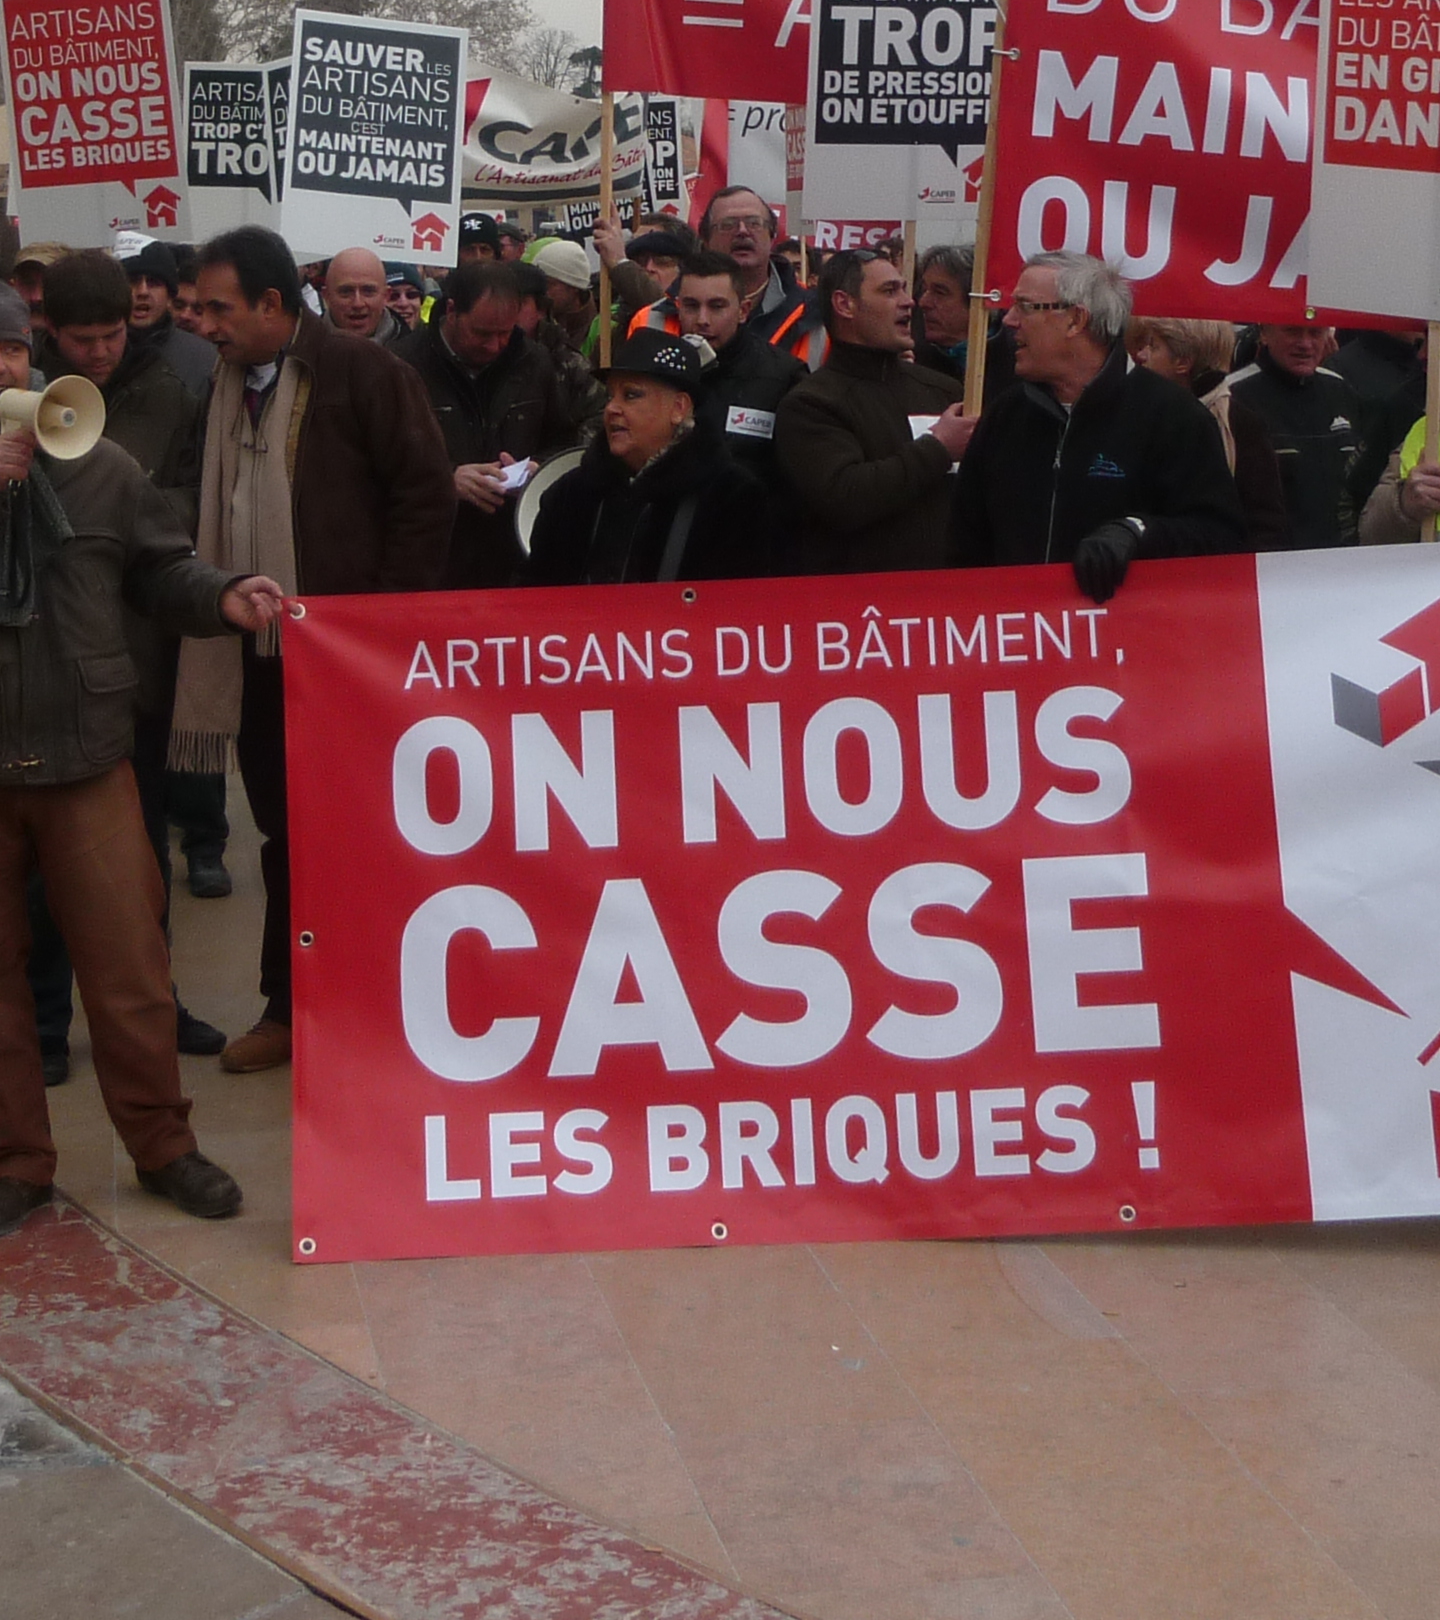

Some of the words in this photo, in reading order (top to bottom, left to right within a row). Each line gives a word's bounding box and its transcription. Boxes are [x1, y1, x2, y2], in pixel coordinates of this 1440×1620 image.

[11, 2, 155, 41] ARTISANS
[830, 5, 998, 67] TROP
[1337, 16, 1381, 47] DU
[13, 47, 44, 69] DU
[49, 36, 160, 67] BÂTIMENT,
[304, 37, 425, 73] SAUVER
[426, 62, 452, 77] LES
[1335, 52, 1389, 90] EN
[16, 69, 62, 102] ON
[71, 61, 162, 97] NOUS
[302, 65, 451, 103] ARTISANS
[824, 70, 860, 94] DE
[21, 96, 168, 146] CASSE
[192, 104, 215, 120] DU
[302, 94, 332, 116] DU
[339, 96, 448, 131] BÂTIMENT,
[822, 97, 864, 124] ON
[870, 90, 991, 124] ÉTOUFF
[191, 122, 242, 140] TROP
[298, 129, 448, 161] MAINTENANT
[351, 121, 386, 135] C'EST
[23, 147, 65, 171] LES
[71, 140, 172, 168] BRIQUES
[297, 151, 336, 176] OU
[340, 155, 446, 188] JAMAIS
[572, 214, 594, 231] OU
[1016, 175, 1177, 281] OU
[404, 628, 695, 691] ARTISANS
[716, 621, 792, 677] DU
[816, 605, 1125, 671] BÂTIMENT,
[391, 708, 619, 857] ON
[678, 685, 1133, 846] NOUS
[399, 851, 1162, 1084] CASSE
[424, 1108, 614, 1202] LES
[646, 1084, 1098, 1193] BRIQUES
[1131, 1080, 1161, 1171] !
